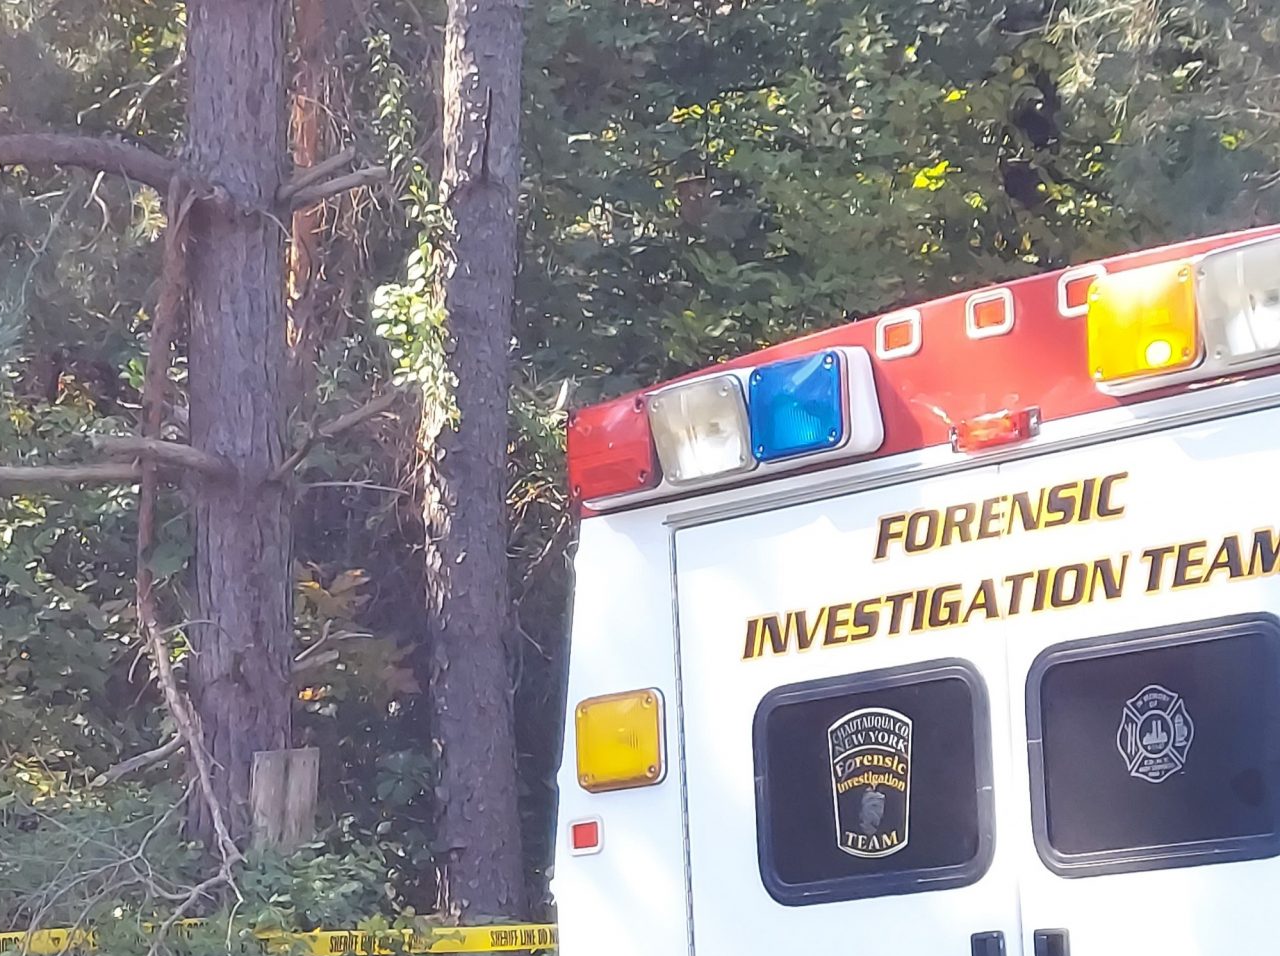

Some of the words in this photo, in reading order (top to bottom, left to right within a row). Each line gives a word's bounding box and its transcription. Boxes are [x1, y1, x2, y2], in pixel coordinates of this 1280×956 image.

[872, 470, 1130, 561] FORENSIC
[741, 553, 1130, 660] INVESTIGATION
[1140, 527, 1280, 594] TEAM
[832, 715, 895, 744] CHAUTAUQUA
[834, 731, 866, 755] NEW
[869, 731, 908, 754] YORK
[835, 754, 907, 778] Forensic
[845, 830, 898, 850] TEAM
